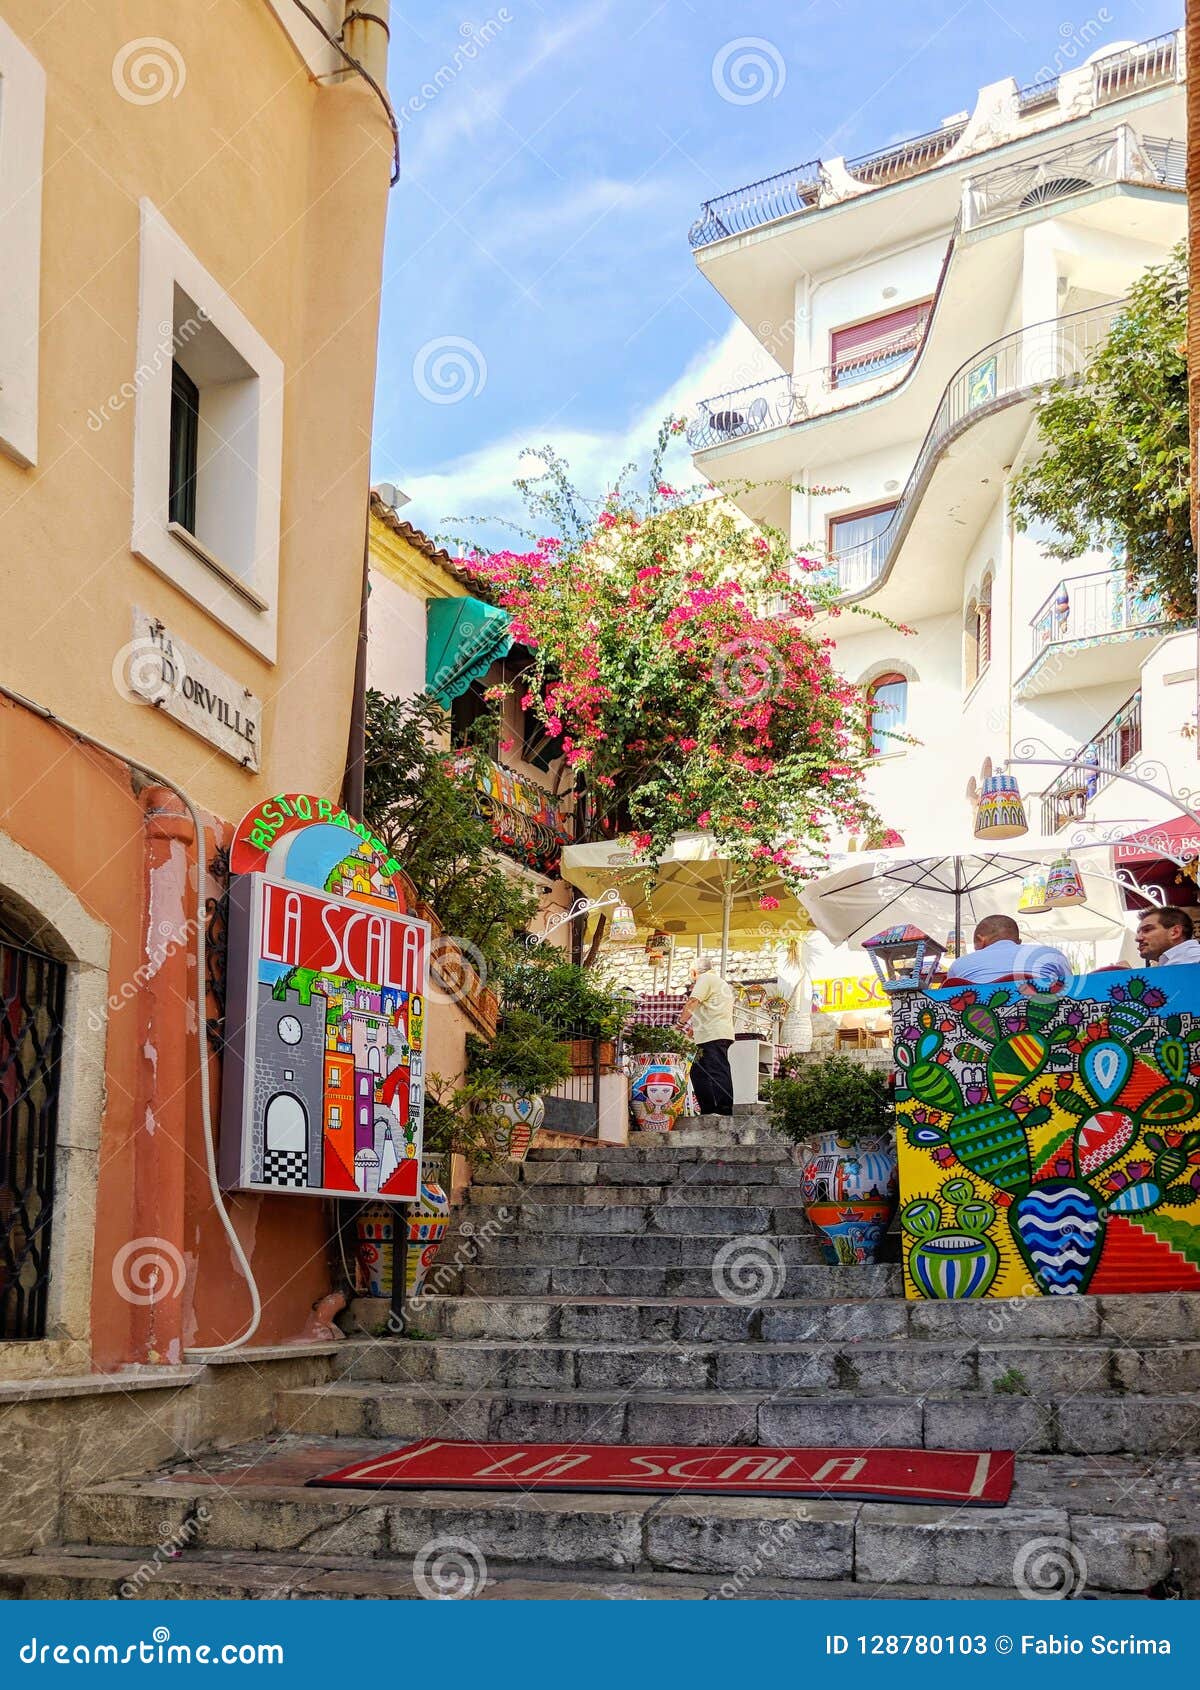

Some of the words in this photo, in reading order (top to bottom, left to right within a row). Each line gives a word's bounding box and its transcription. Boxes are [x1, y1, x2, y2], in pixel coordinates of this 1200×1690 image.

[149, 625, 174, 658] VIA
[250, 793, 402, 878] RISTORANTE
[262, 885, 301, 966] LA
[321, 903, 418, 994] SCALA
[823, 979, 845, 1005] LA
[472, 1452, 592, 1477] LA
[608, 1455, 868, 1481] SCALA
